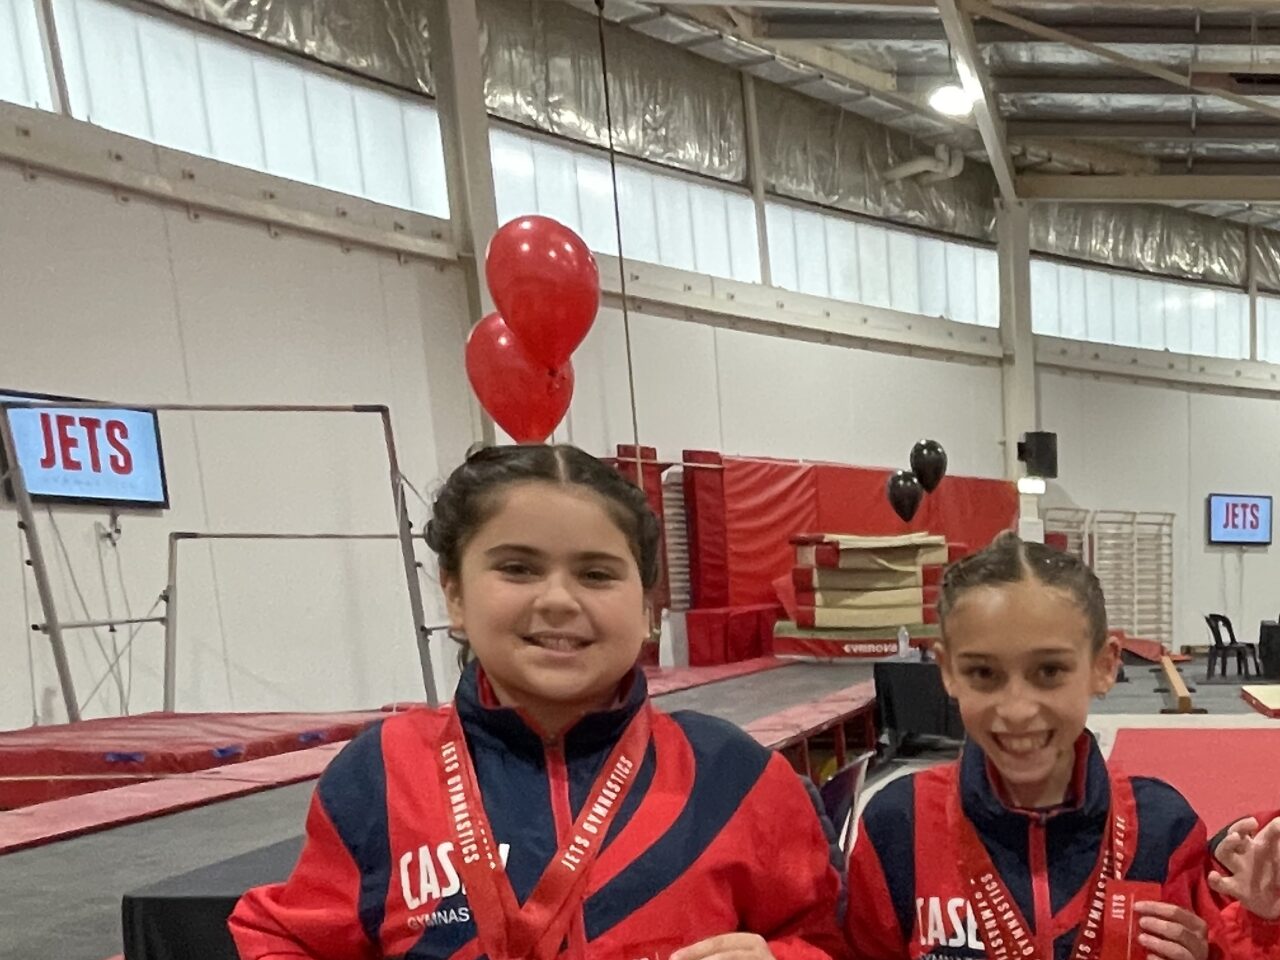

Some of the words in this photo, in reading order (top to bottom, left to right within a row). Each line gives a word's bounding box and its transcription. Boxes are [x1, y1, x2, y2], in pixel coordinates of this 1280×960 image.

[40, 412, 134, 476] JETS
[1222, 502, 1260, 530] JETS
[441, 741, 460, 773] JETS
[447, 774, 480, 864] GYMNASTICS
[561, 834, 590, 872] JETS
[582, 755, 634, 835] GYMNASTICS
[981, 873, 1034, 956] GYMNASTICS
